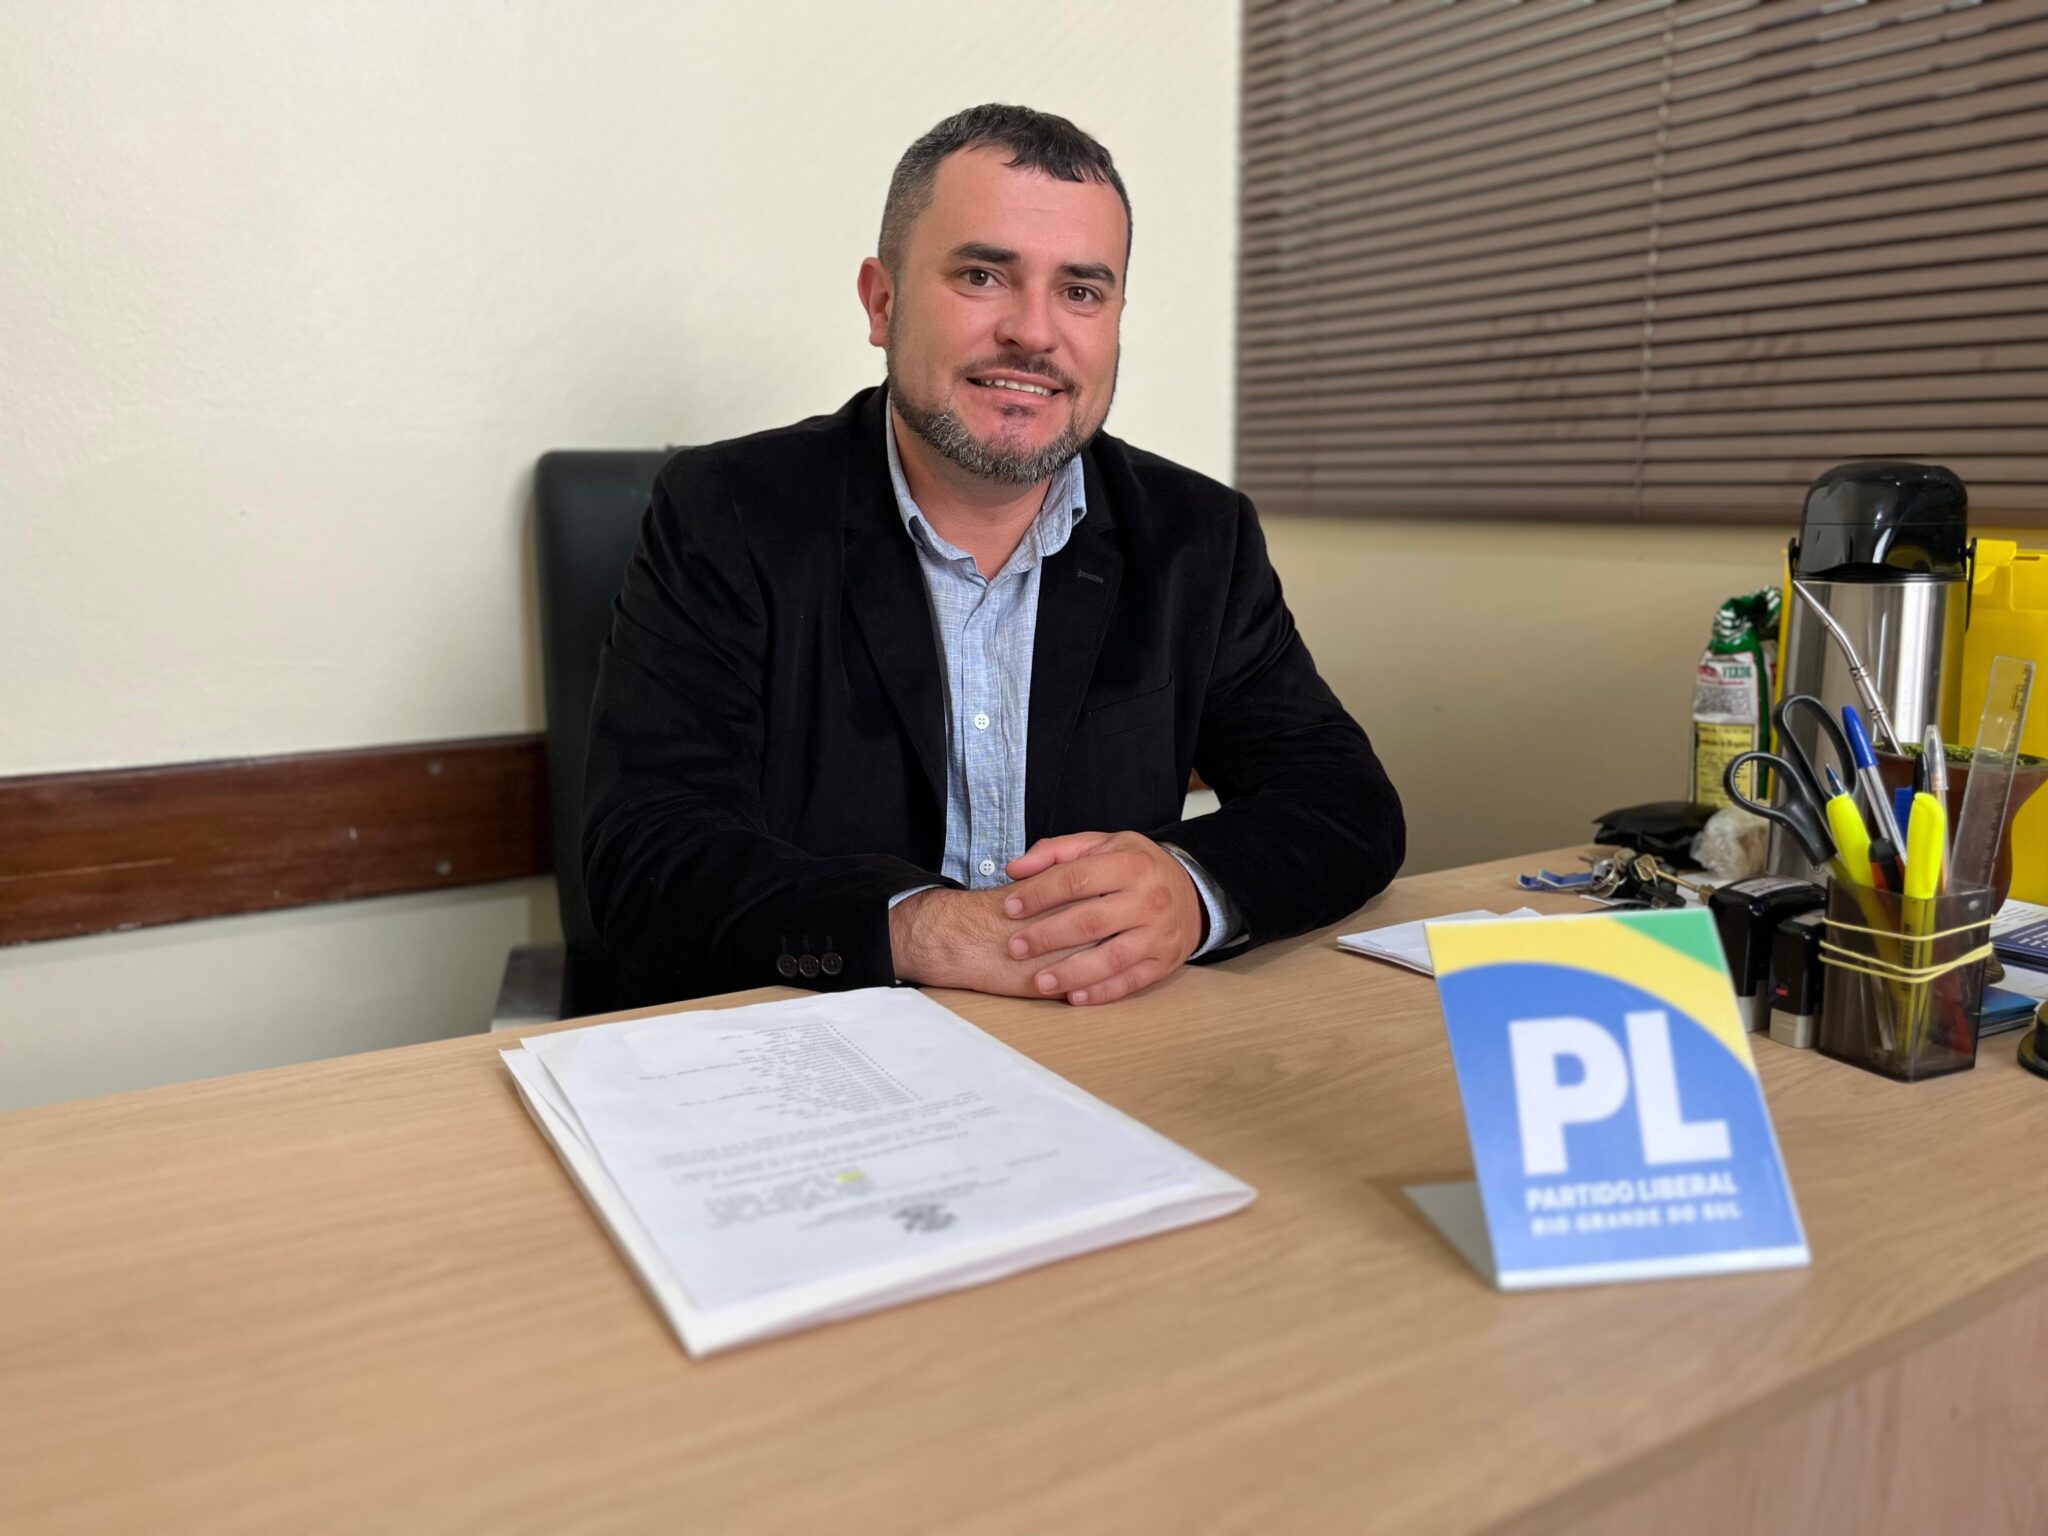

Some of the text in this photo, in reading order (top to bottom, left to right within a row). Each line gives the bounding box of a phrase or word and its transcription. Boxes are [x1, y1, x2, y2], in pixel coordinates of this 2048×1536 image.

[1509, 1011, 1732, 1176] PL
[1526, 1173, 1737, 1211] PARTIDO LIBERAL
[1532, 1203, 1741, 1235] RIO GRANDE DO SUL
